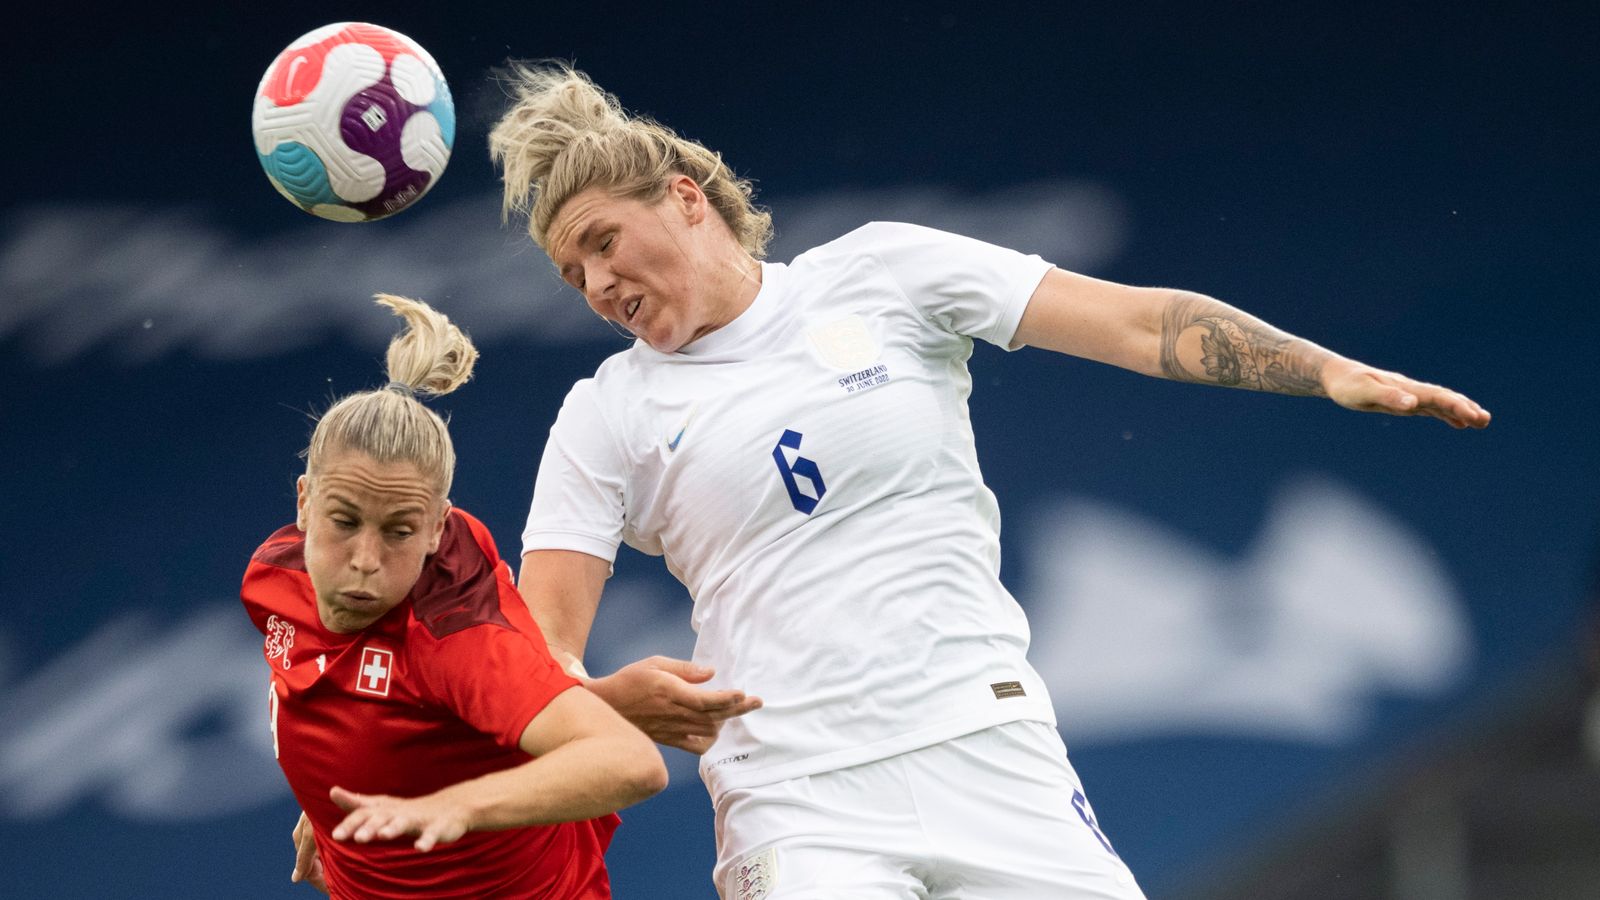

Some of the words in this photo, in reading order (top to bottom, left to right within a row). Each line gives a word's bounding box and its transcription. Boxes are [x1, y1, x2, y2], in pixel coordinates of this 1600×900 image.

[838, 364, 888, 388] SWITZERLAND
[856, 378, 875, 390] JUNE
[874, 373, 890, 385] 2022
[772, 428, 827, 516] 6
